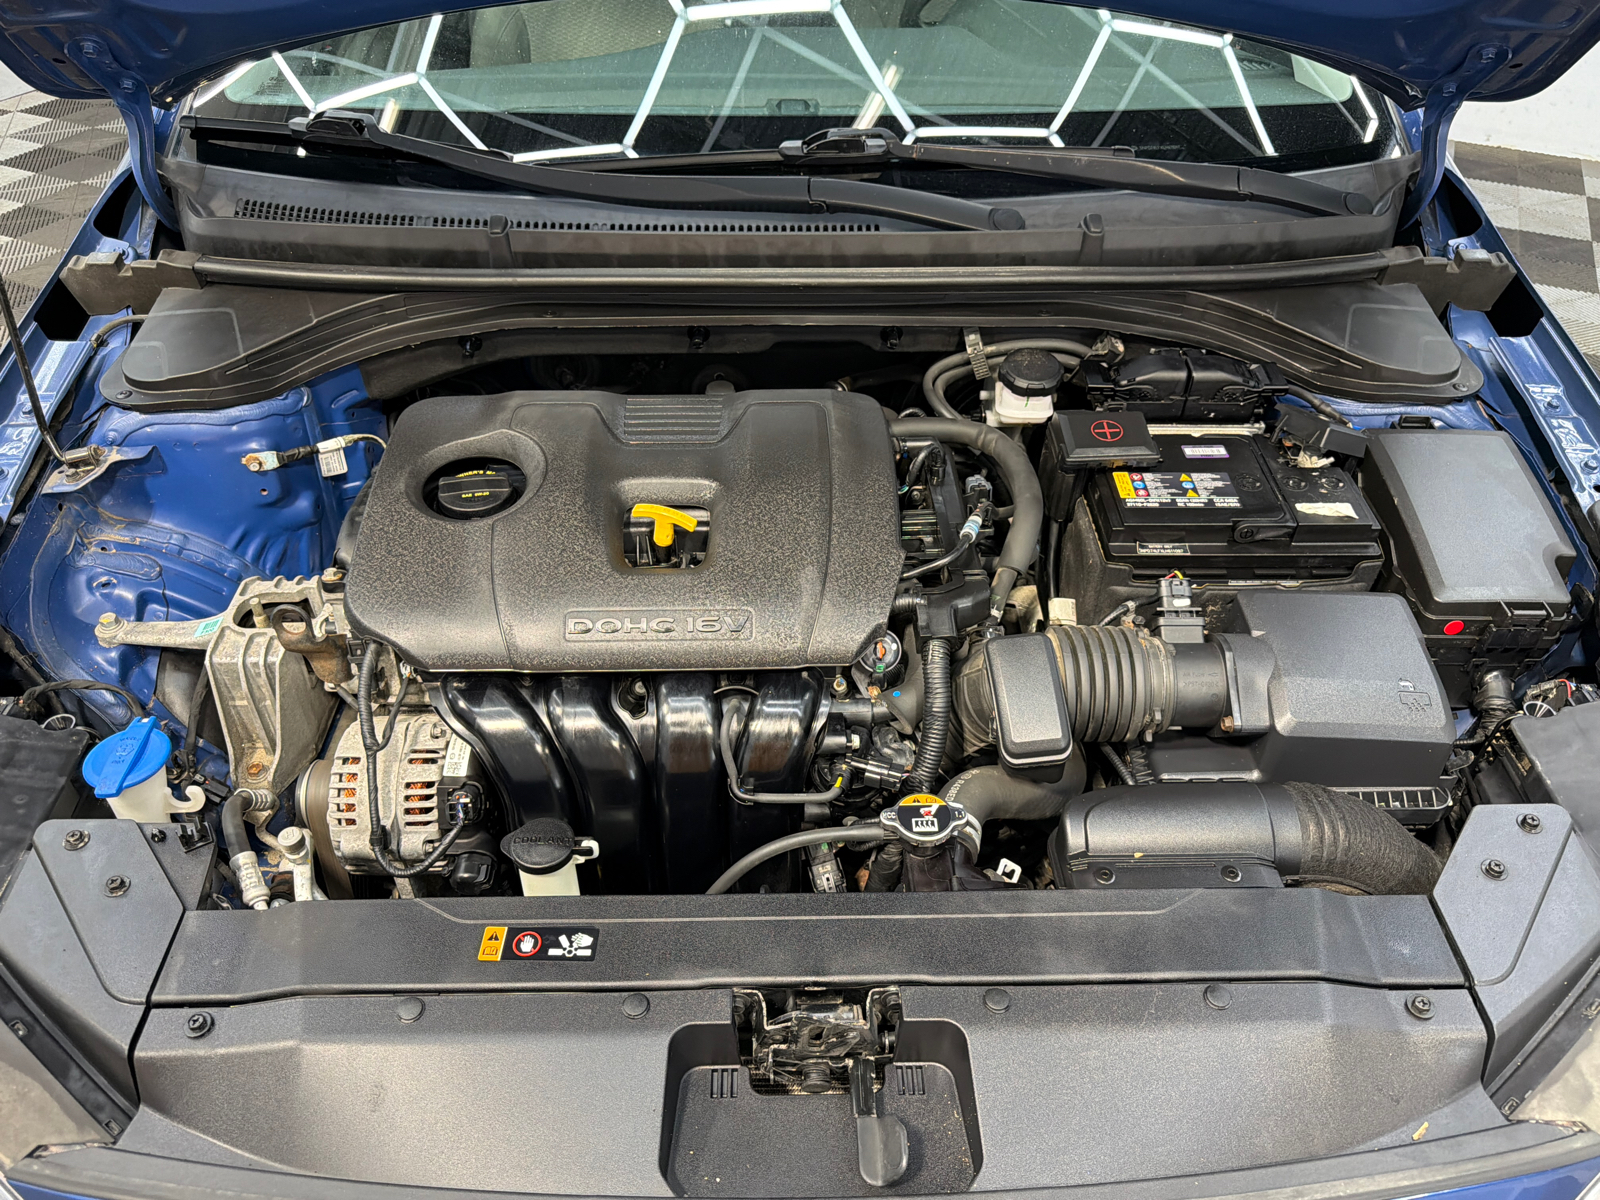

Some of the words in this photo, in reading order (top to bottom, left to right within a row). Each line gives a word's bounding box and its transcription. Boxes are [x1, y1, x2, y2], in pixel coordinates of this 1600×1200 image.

[568, 617, 675, 634] DOHC
[686, 616, 750, 633] 16V
[513, 835, 574, 847] COOLANT
